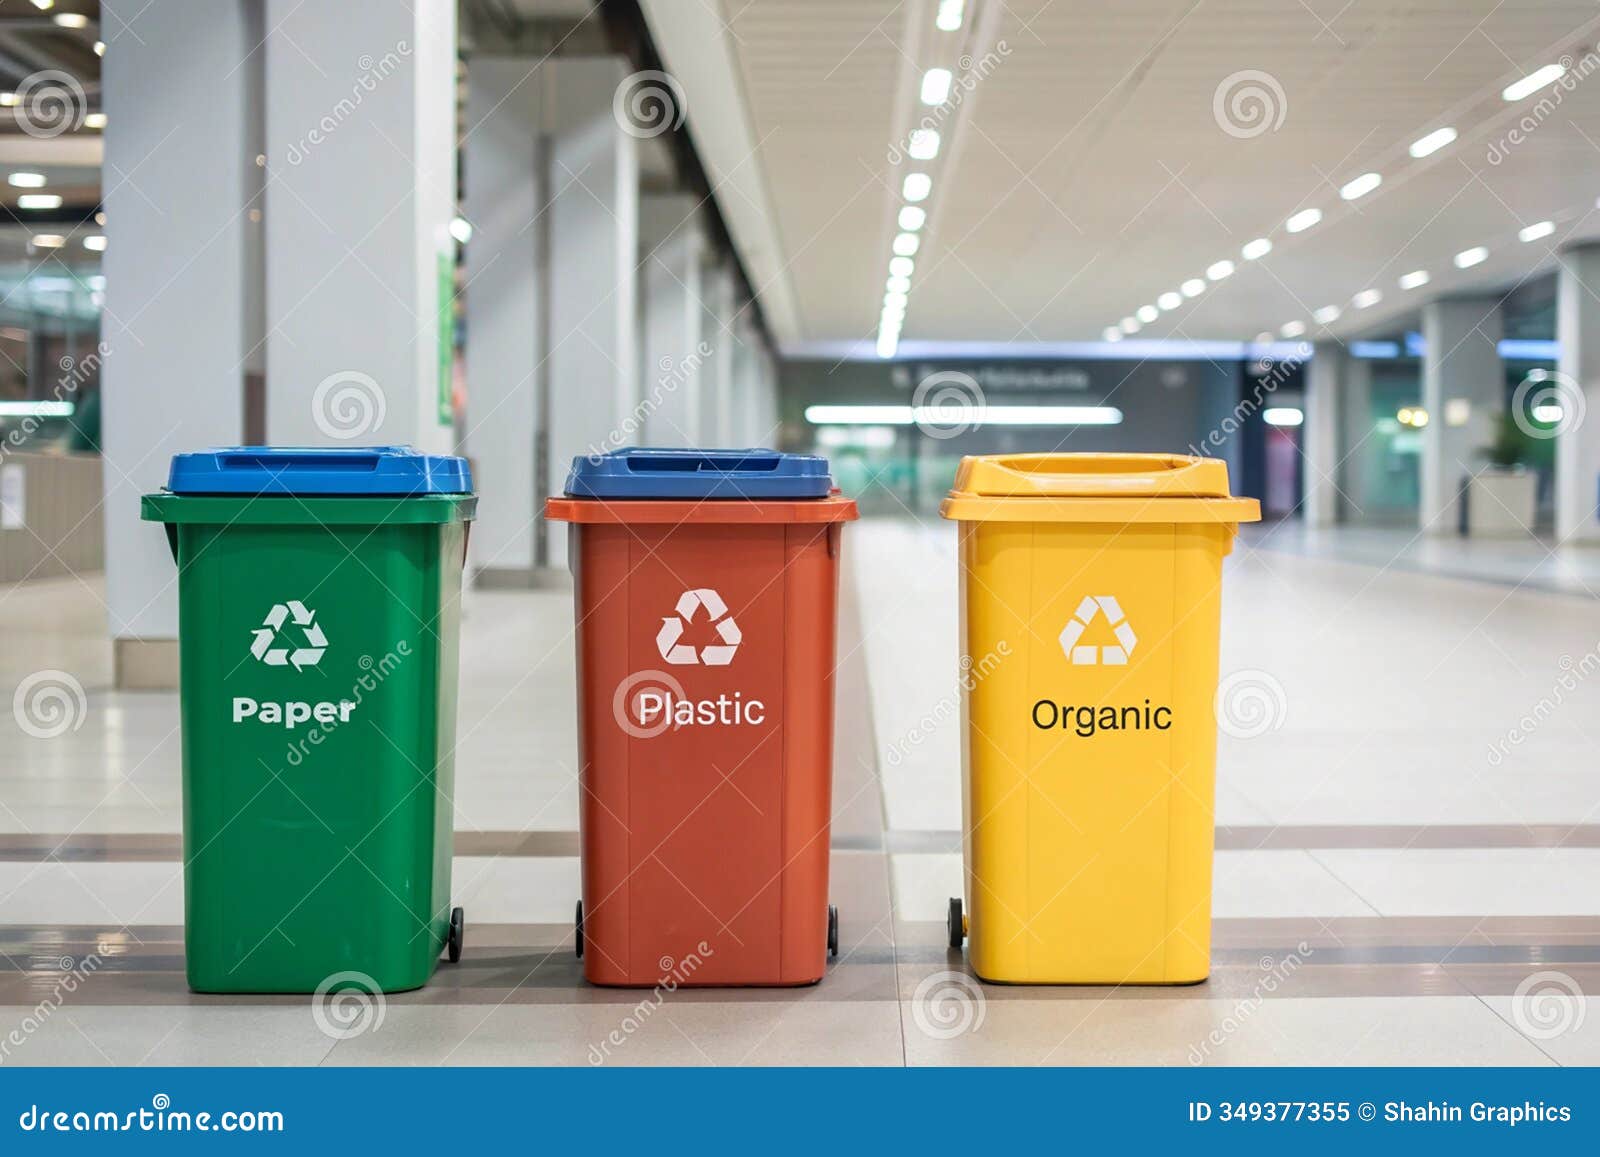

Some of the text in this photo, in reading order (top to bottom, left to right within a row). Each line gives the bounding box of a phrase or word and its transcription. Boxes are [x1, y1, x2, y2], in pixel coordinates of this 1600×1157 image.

[233, 697, 356, 729] Paper
[639, 691, 765, 726] Plastic
[1032, 699, 1172, 738] Organic
